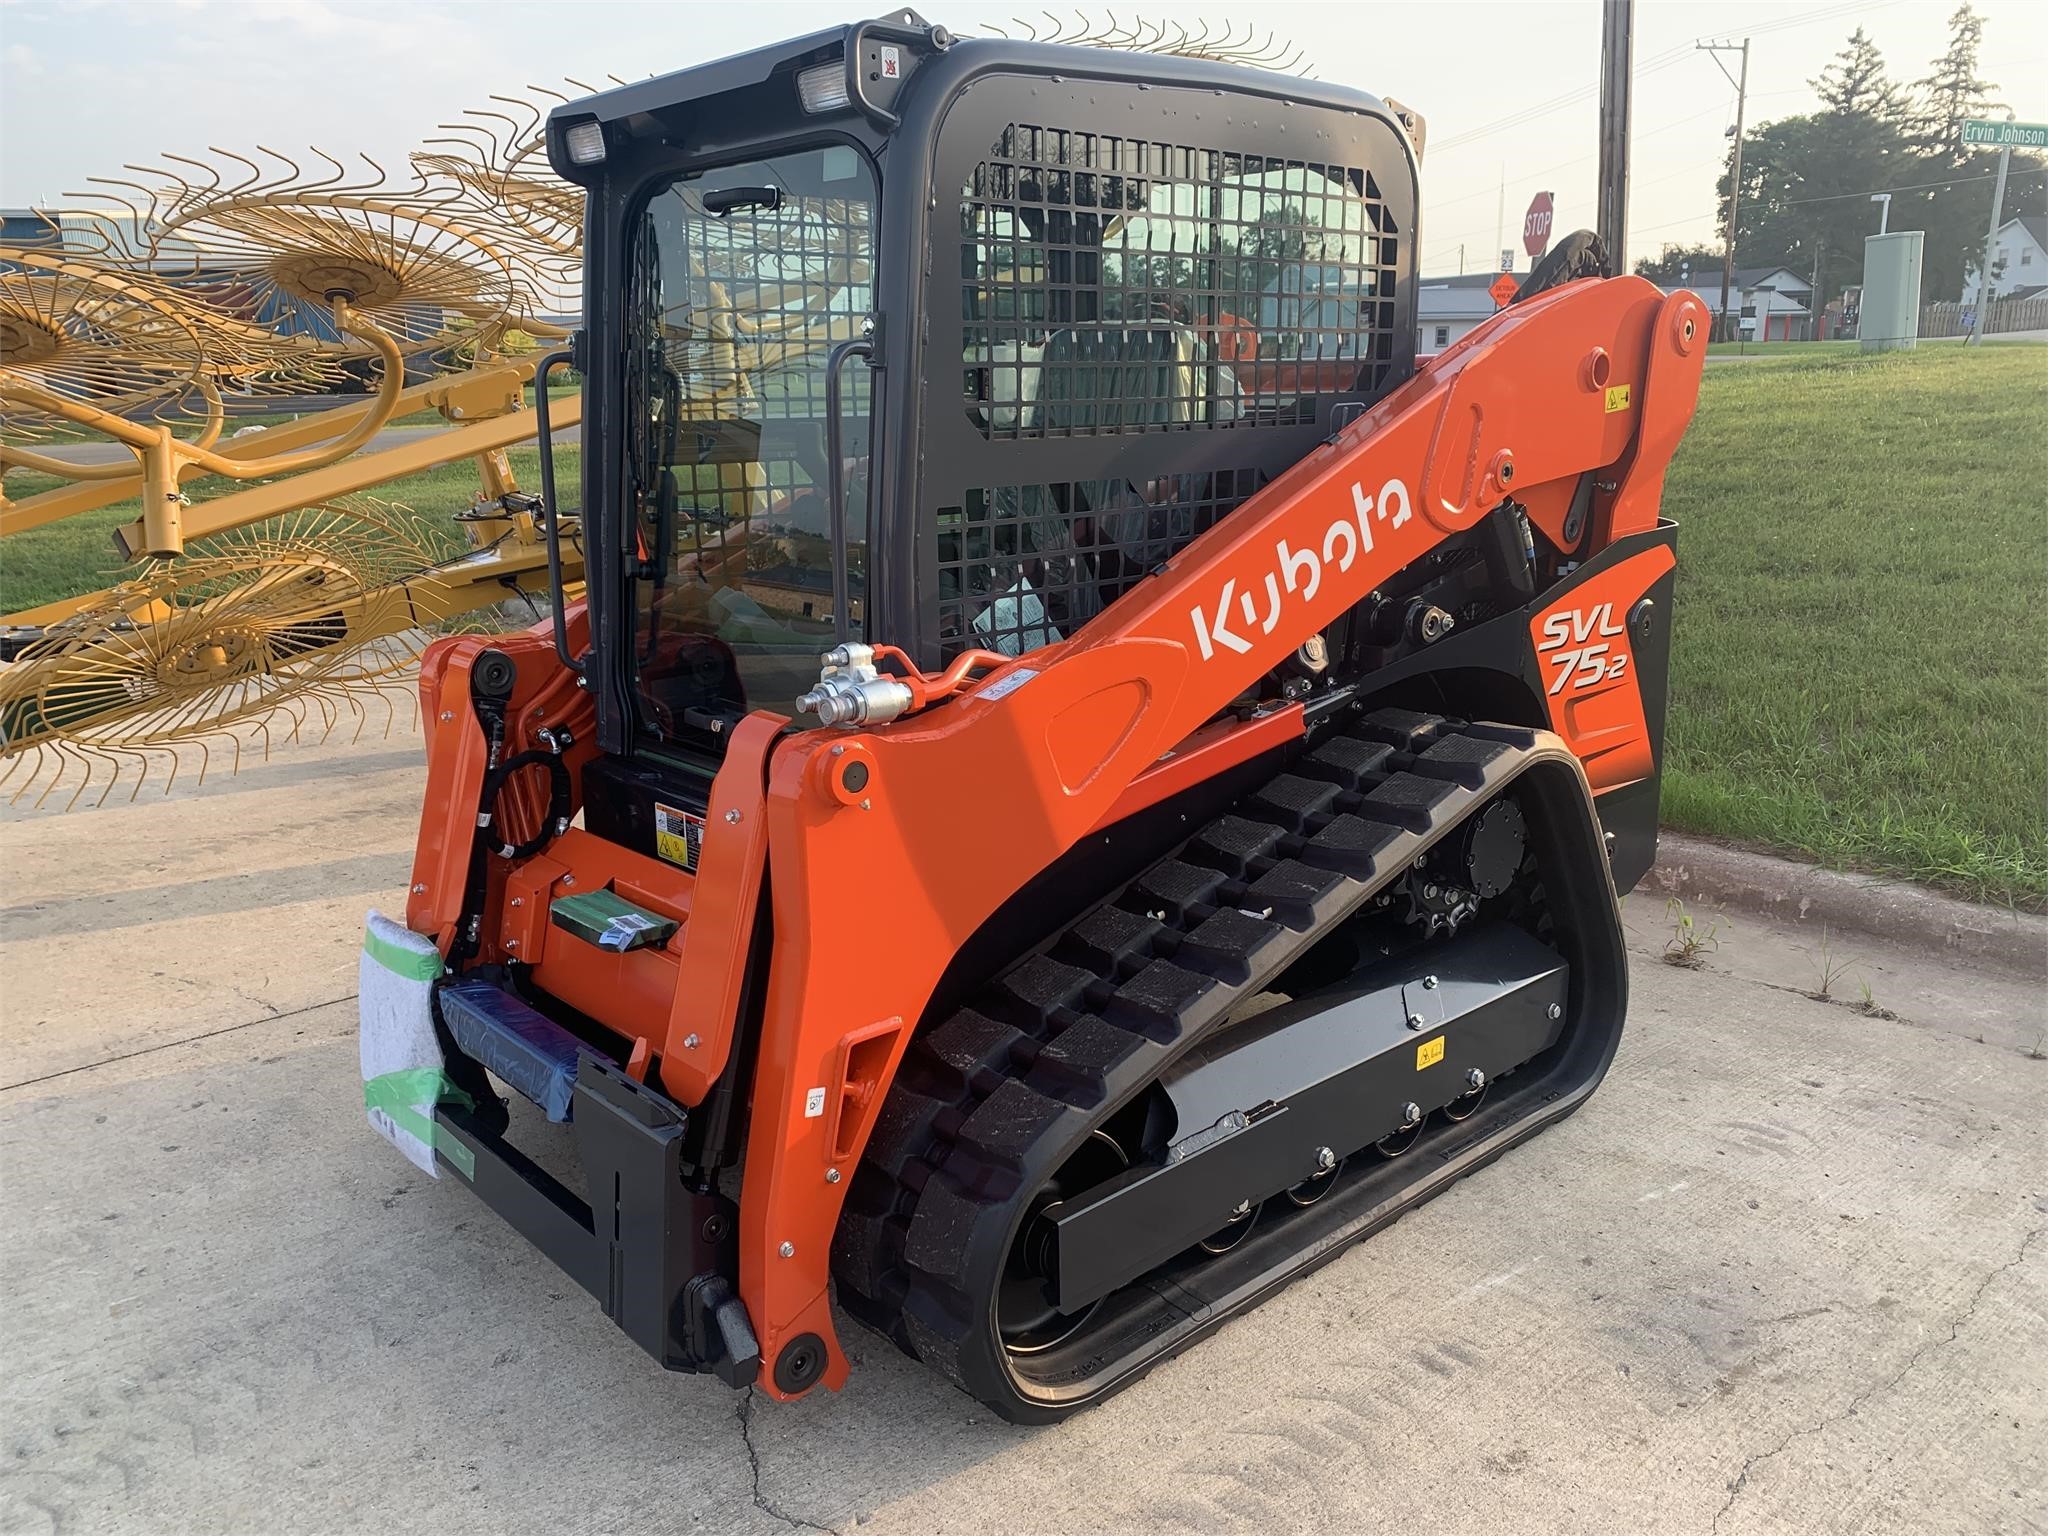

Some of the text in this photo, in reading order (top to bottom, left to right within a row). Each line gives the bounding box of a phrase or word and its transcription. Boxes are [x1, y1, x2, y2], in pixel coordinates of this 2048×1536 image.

[1965, 122, 2045, 145] Ervin Johnson
[1525, 211, 1551, 237] STOP
[1190, 478, 1413, 662] Kubota
[1537, 602, 1625, 652] SVL
[1548, 643, 1628, 695] 75-2
